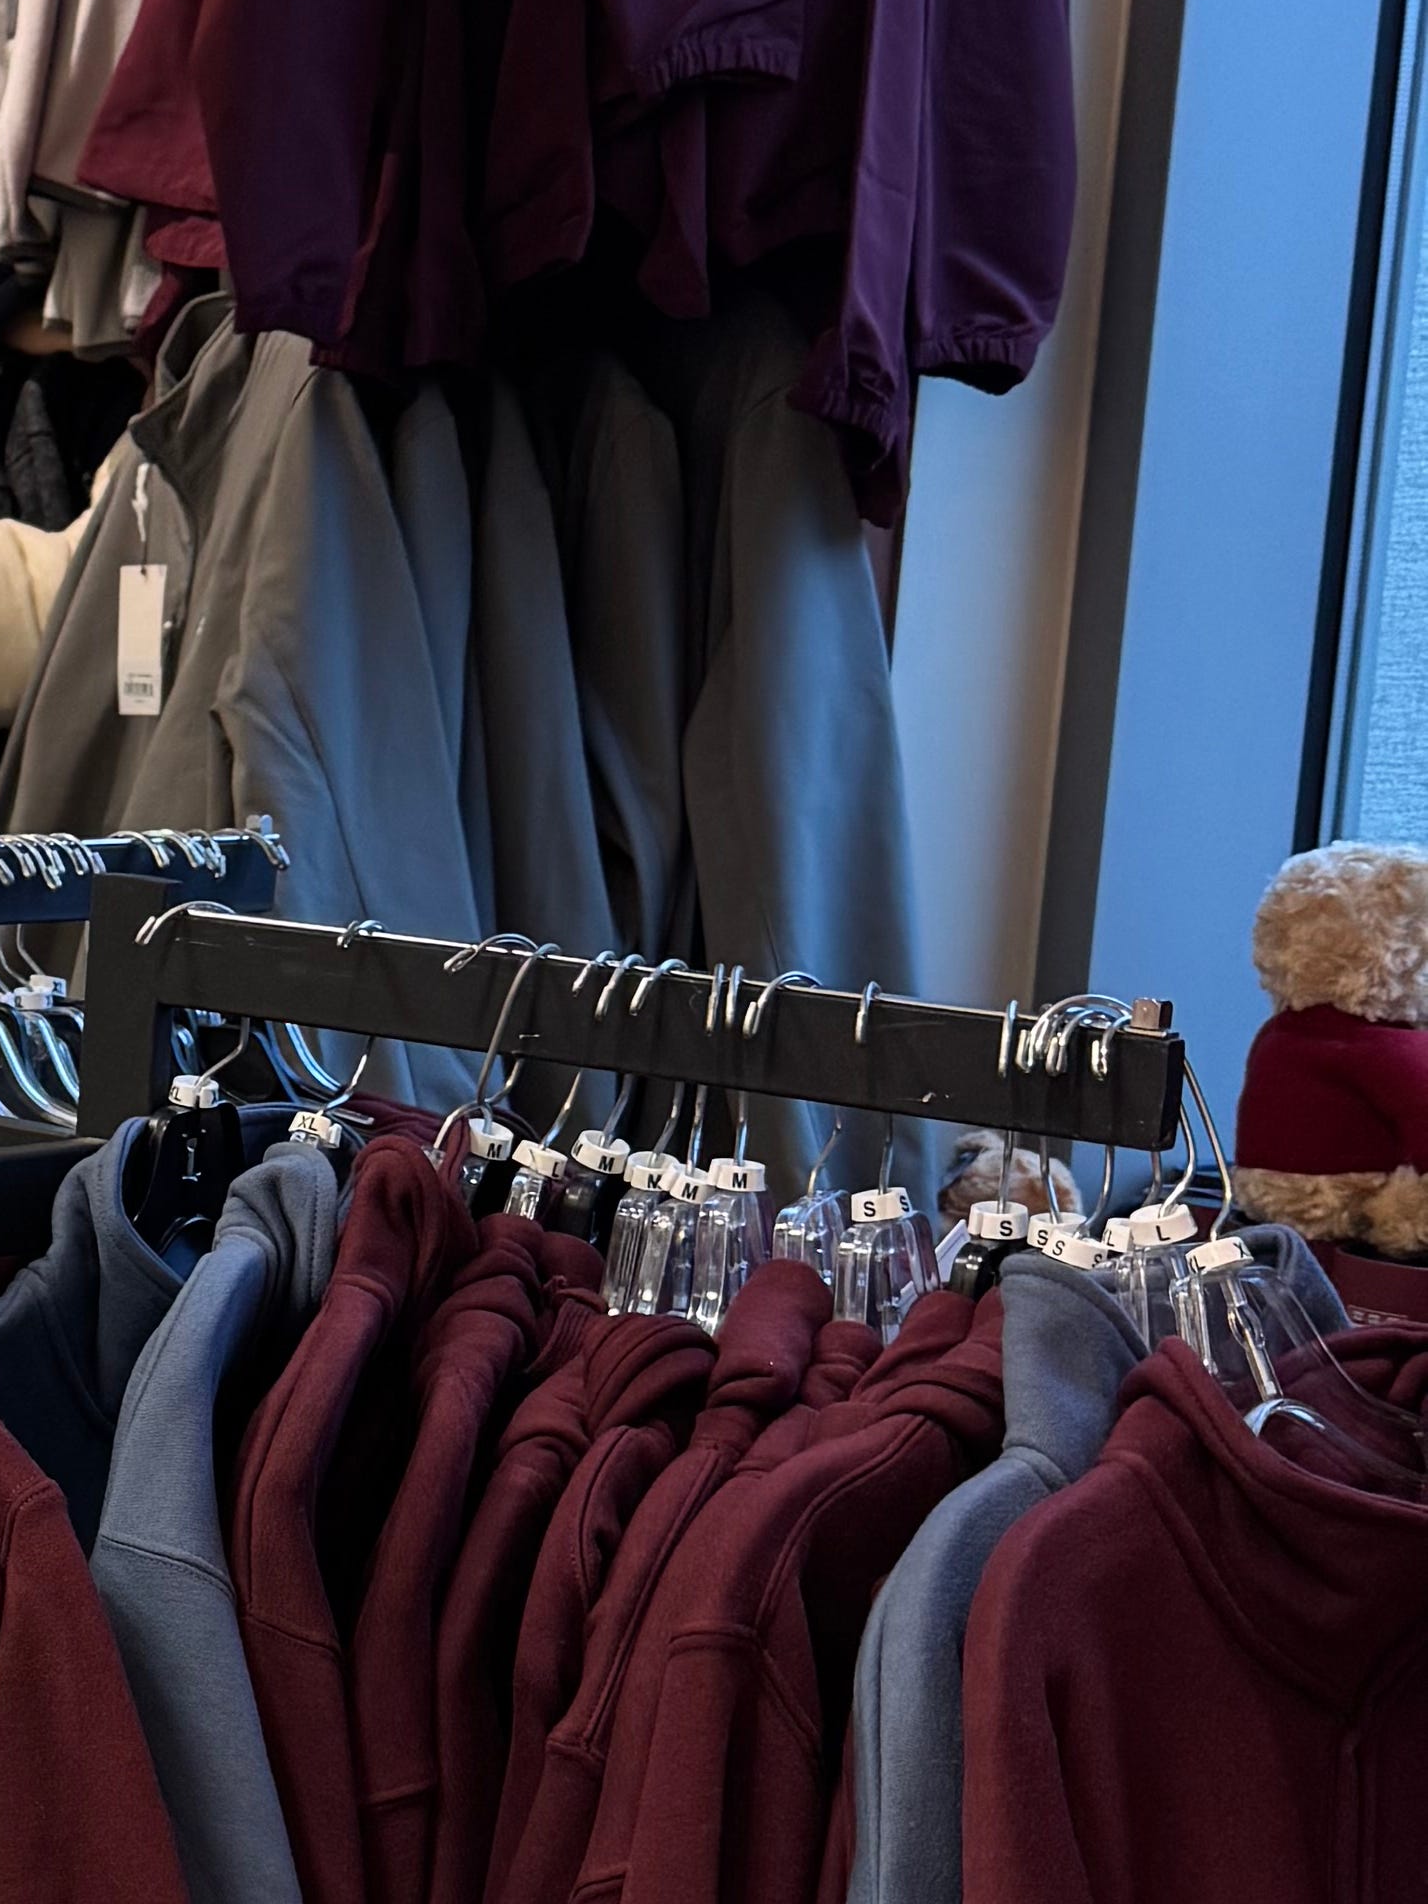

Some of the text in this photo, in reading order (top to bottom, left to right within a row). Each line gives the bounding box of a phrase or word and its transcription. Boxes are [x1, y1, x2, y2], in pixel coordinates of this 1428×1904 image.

[297, 1115, 318, 1132] XL
[487, 1143, 503, 1159] M
[552, 1161, 561, 1179] L
[598, 1155, 616, 1172] M
[732, 1172, 748, 1189] M
[681, 1183, 699, 1201] M
[863, 1200, 877, 1218] S
[999, 1220, 1014, 1237] S
[1155, 1225, 1171, 1242] L
[1036, 1229, 1049, 1246] S
[1052, 1240, 1066, 1257] S
